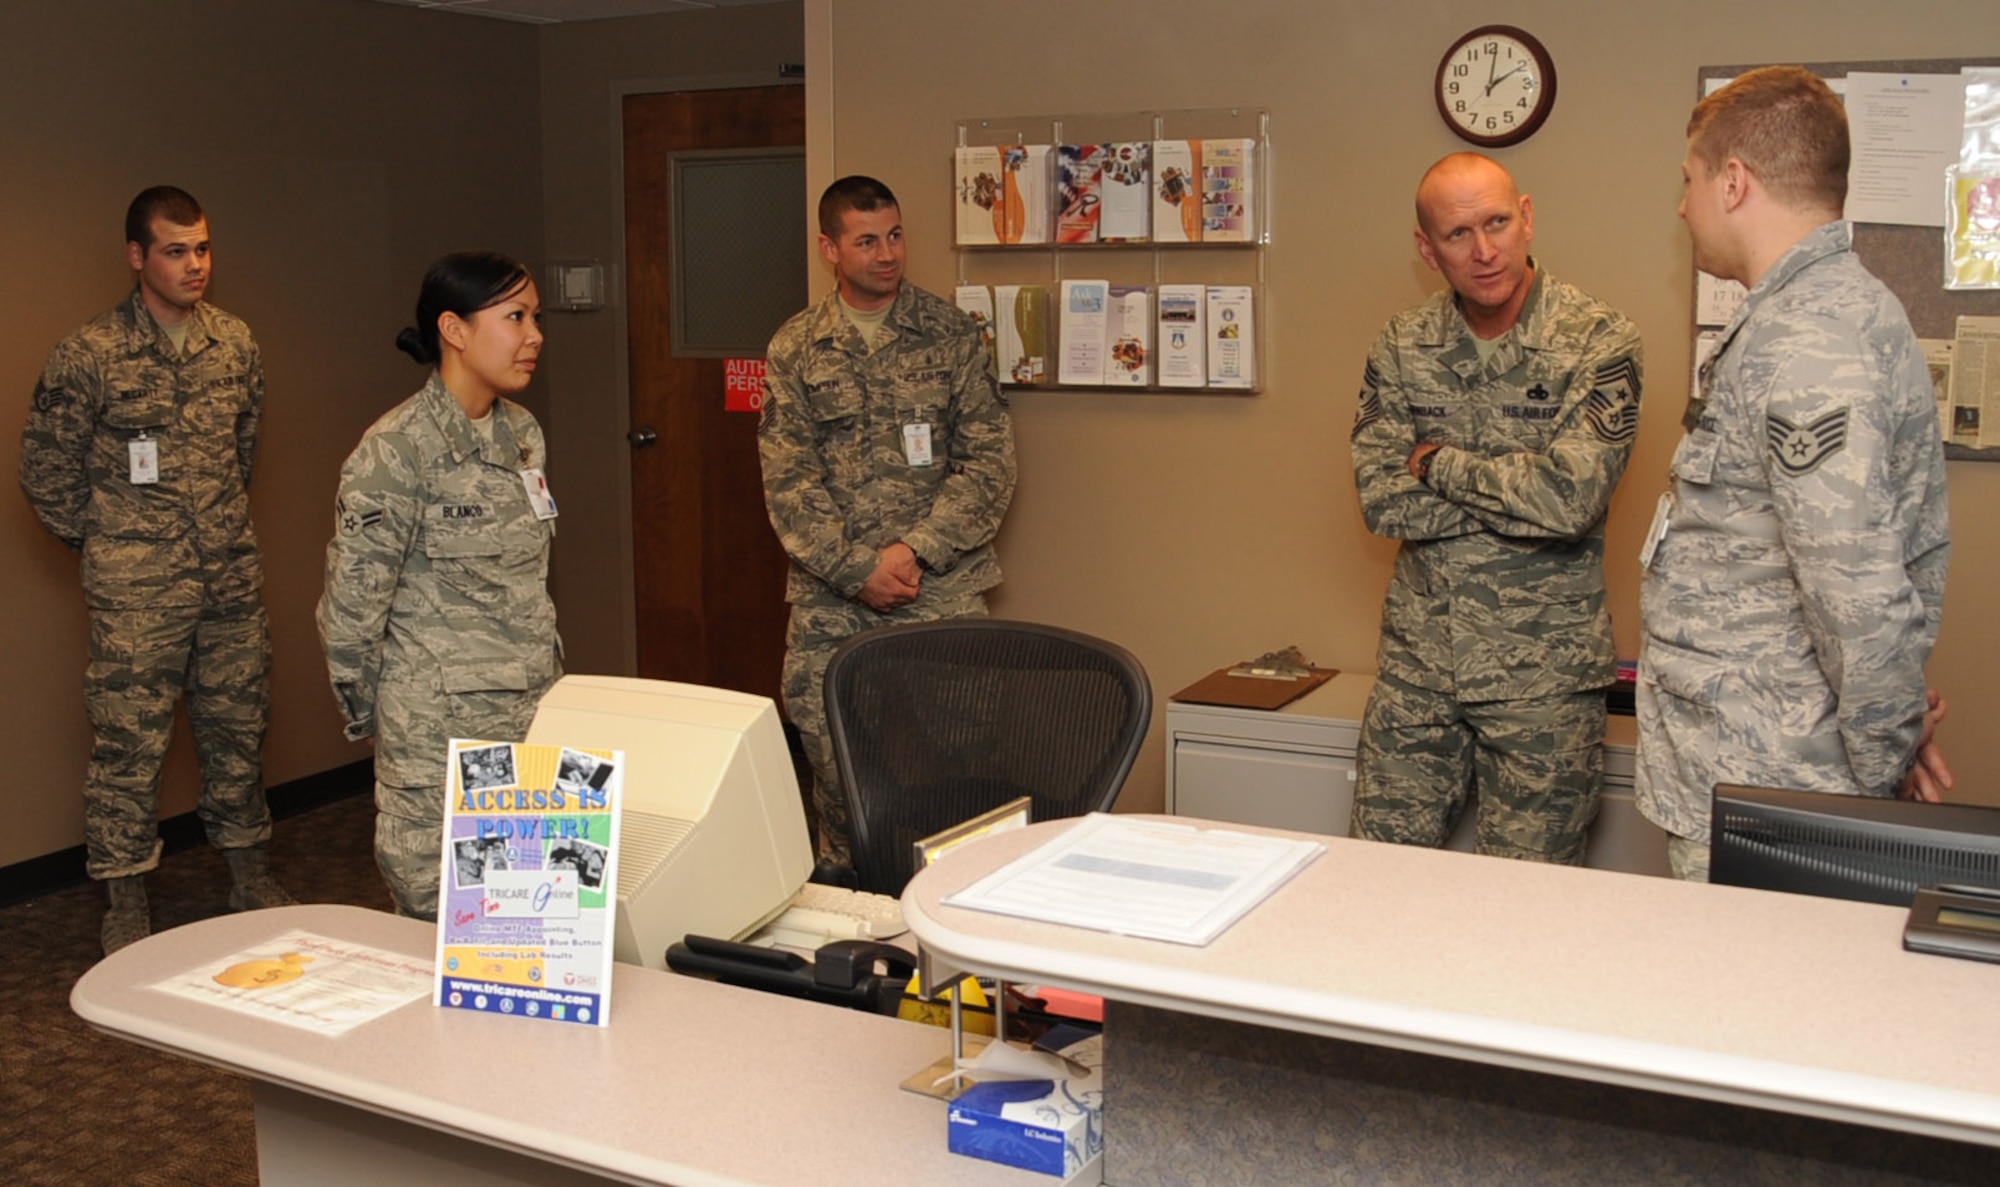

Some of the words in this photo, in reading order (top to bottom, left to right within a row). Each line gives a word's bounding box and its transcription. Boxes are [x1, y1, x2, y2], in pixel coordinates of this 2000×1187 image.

[1468, 49, 1479, 61] 11
[1483, 42, 1498, 55] 12
[1507, 47, 1512, 59] 1
[1453, 64, 1469, 77] 10
[1517, 60, 1528, 72] 2
[1449, 81, 1460, 94] 9
[1522, 77, 1534, 90] 3
[1455, 99, 1466, 112] 8
[1516, 97, 1527, 109] 4
[1469, 112, 1479, 125] 7
[1486, 116, 1497, 129] 6
[1503, 110, 1514, 123] 5
[1713, 291, 1726, 301] 17
[1522, 406, 1541, 419] AIR
[443, 505, 483, 519] BLANCO
[459, 789, 566, 811] ACCESS
[578, 788, 607, 810] IS
[477, 818, 590, 840] POWER!
[489, 888, 530, 899] TRICARE
[450, 980, 593, 1005] www.tricareonline.com
